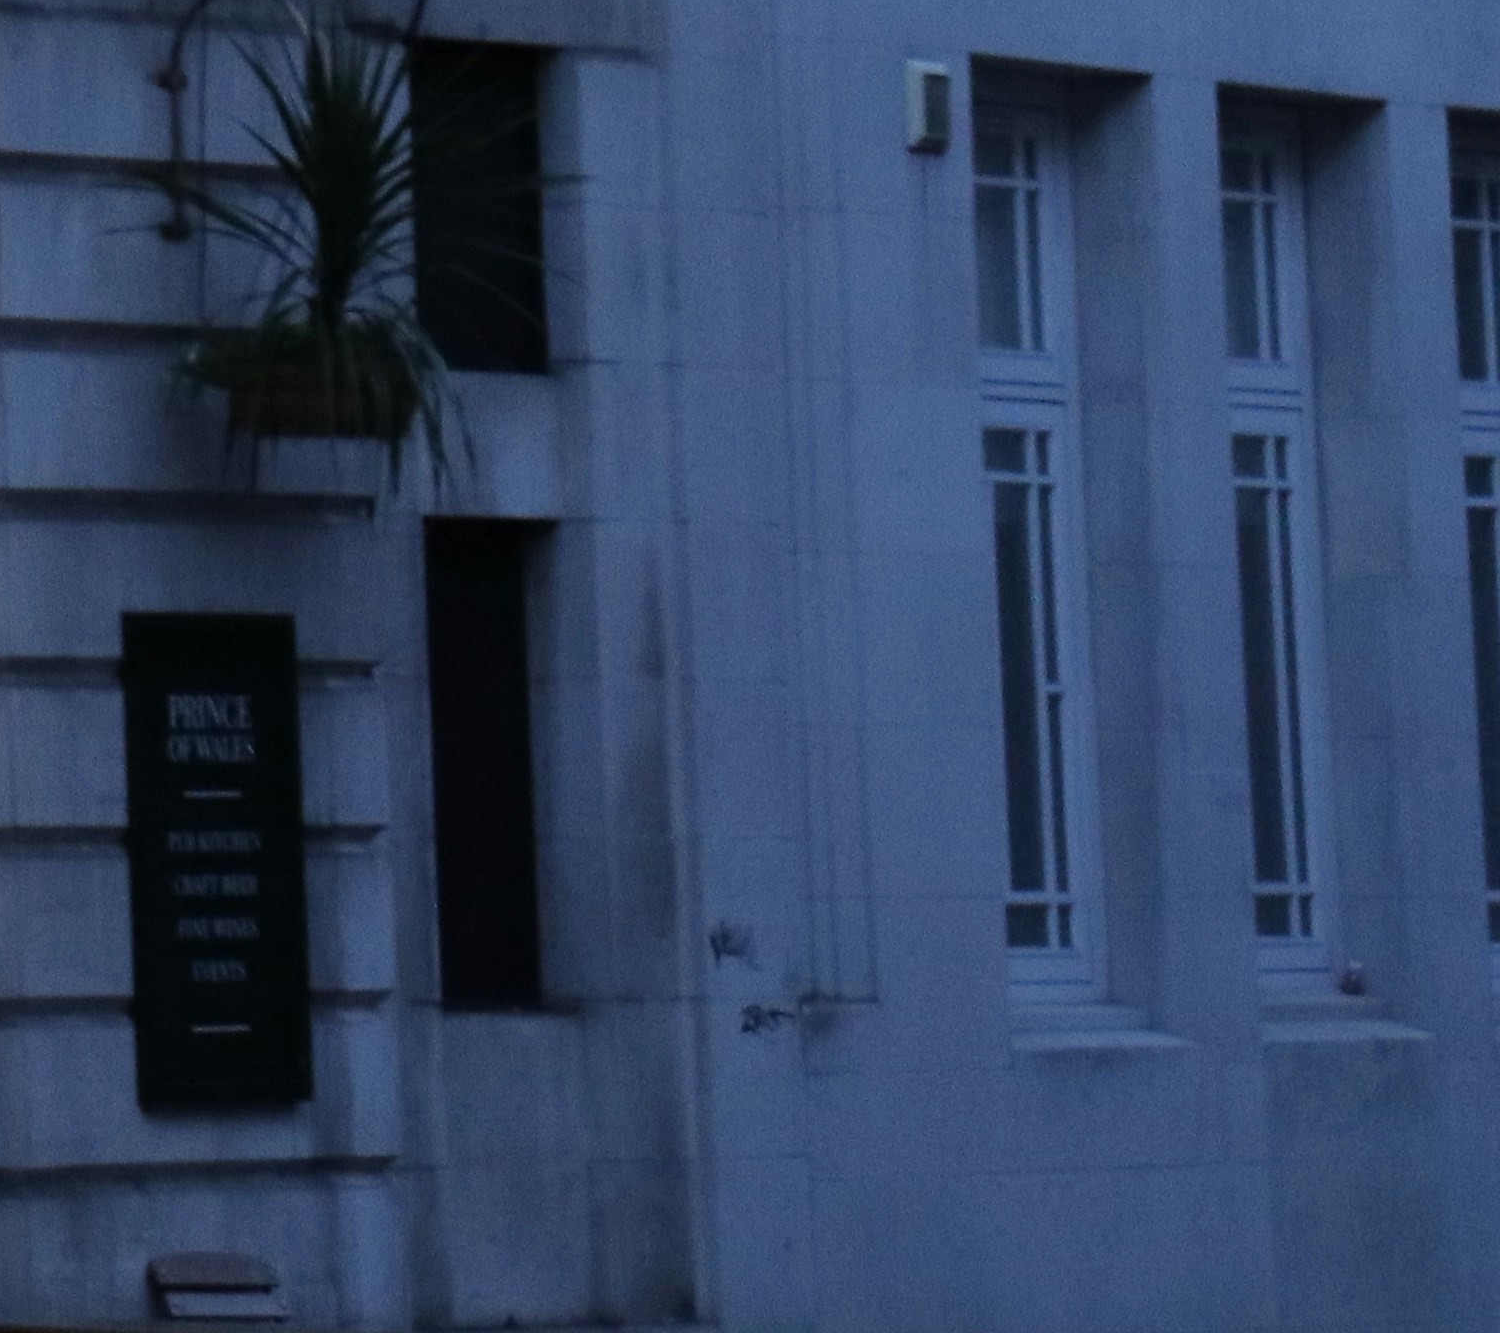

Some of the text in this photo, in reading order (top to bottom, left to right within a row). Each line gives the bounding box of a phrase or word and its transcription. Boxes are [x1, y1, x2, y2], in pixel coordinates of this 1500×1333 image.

[166, 693, 253, 729] PRINCE
[166, 731, 257, 763] OF WALES
